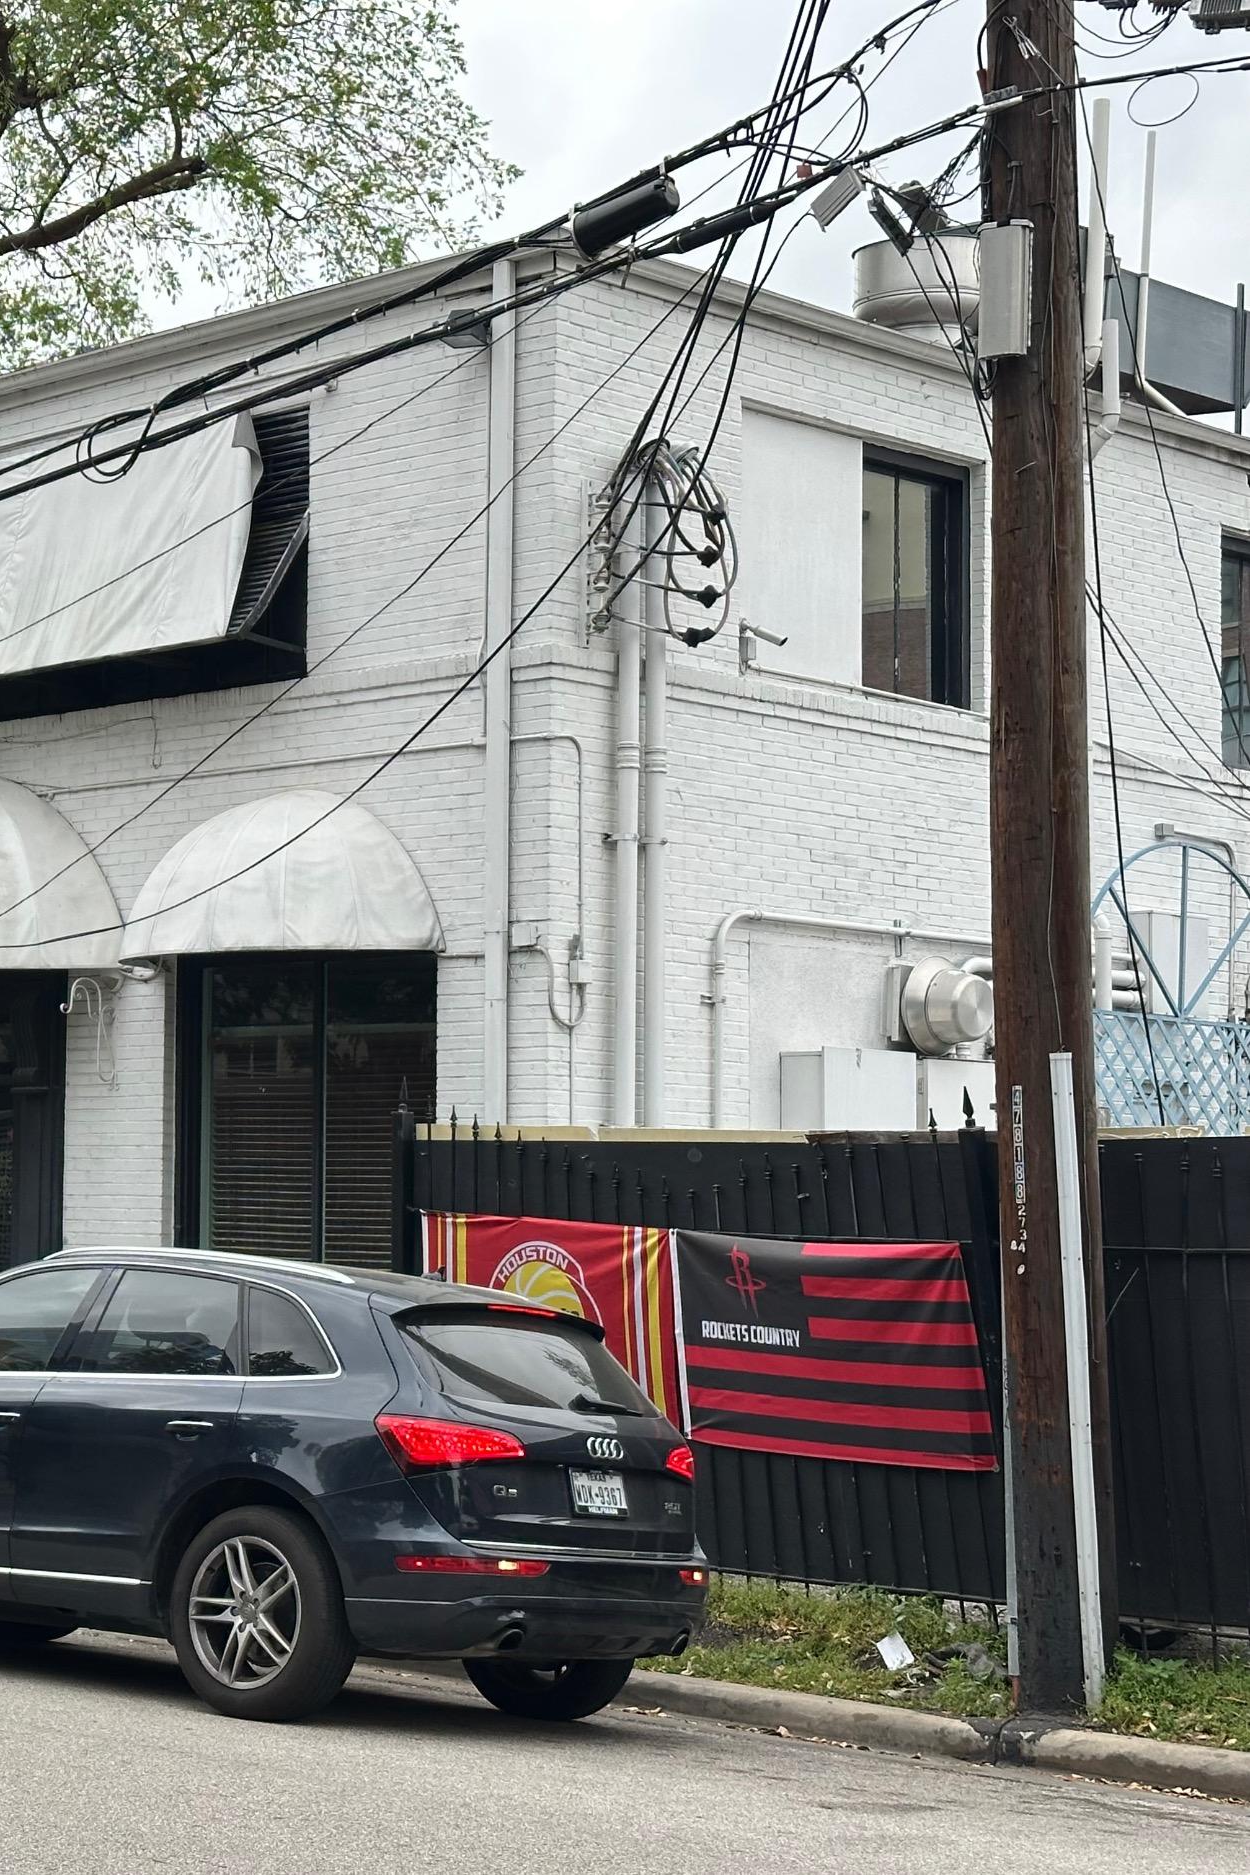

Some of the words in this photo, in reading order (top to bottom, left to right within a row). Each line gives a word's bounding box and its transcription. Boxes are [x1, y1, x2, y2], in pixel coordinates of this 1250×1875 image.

[497, 1246, 569, 1284] HOUSTON
[701, 1320, 749, 1343] ROCKETS
[750, 1325, 800, 1348] COUNTRY
[493, 1484, 518, 1498] Q5
